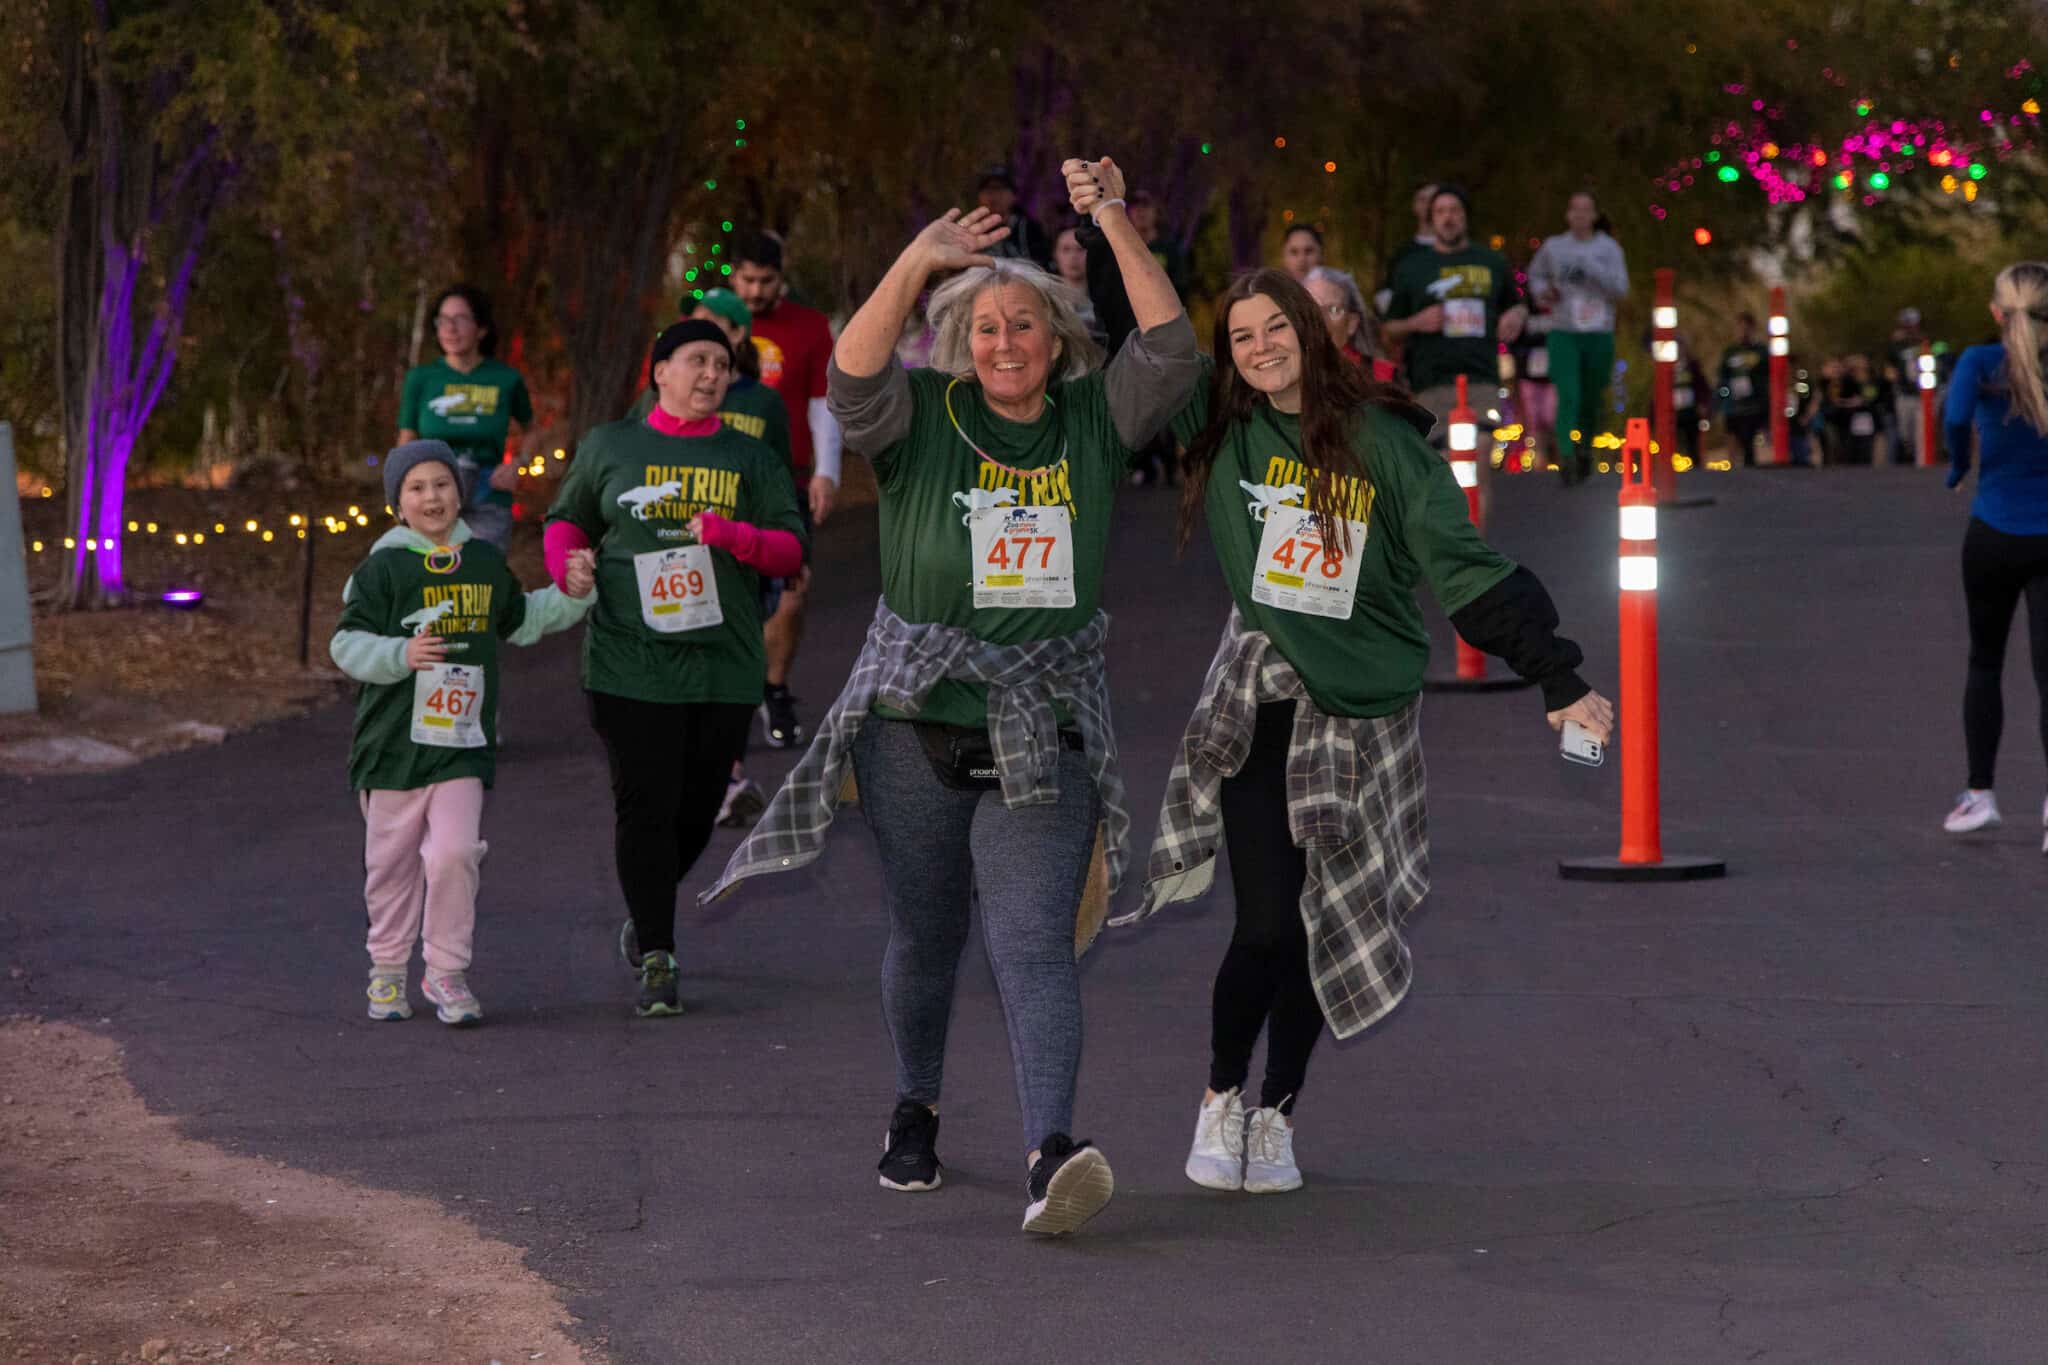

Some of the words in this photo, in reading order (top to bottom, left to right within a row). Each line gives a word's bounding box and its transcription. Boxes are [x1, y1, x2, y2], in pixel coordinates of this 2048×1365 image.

[987, 536, 1056, 570] 477
[1272, 537, 1344, 579] 478
[651, 569, 704, 601] 469
[426, 687, 478, 717] 467
